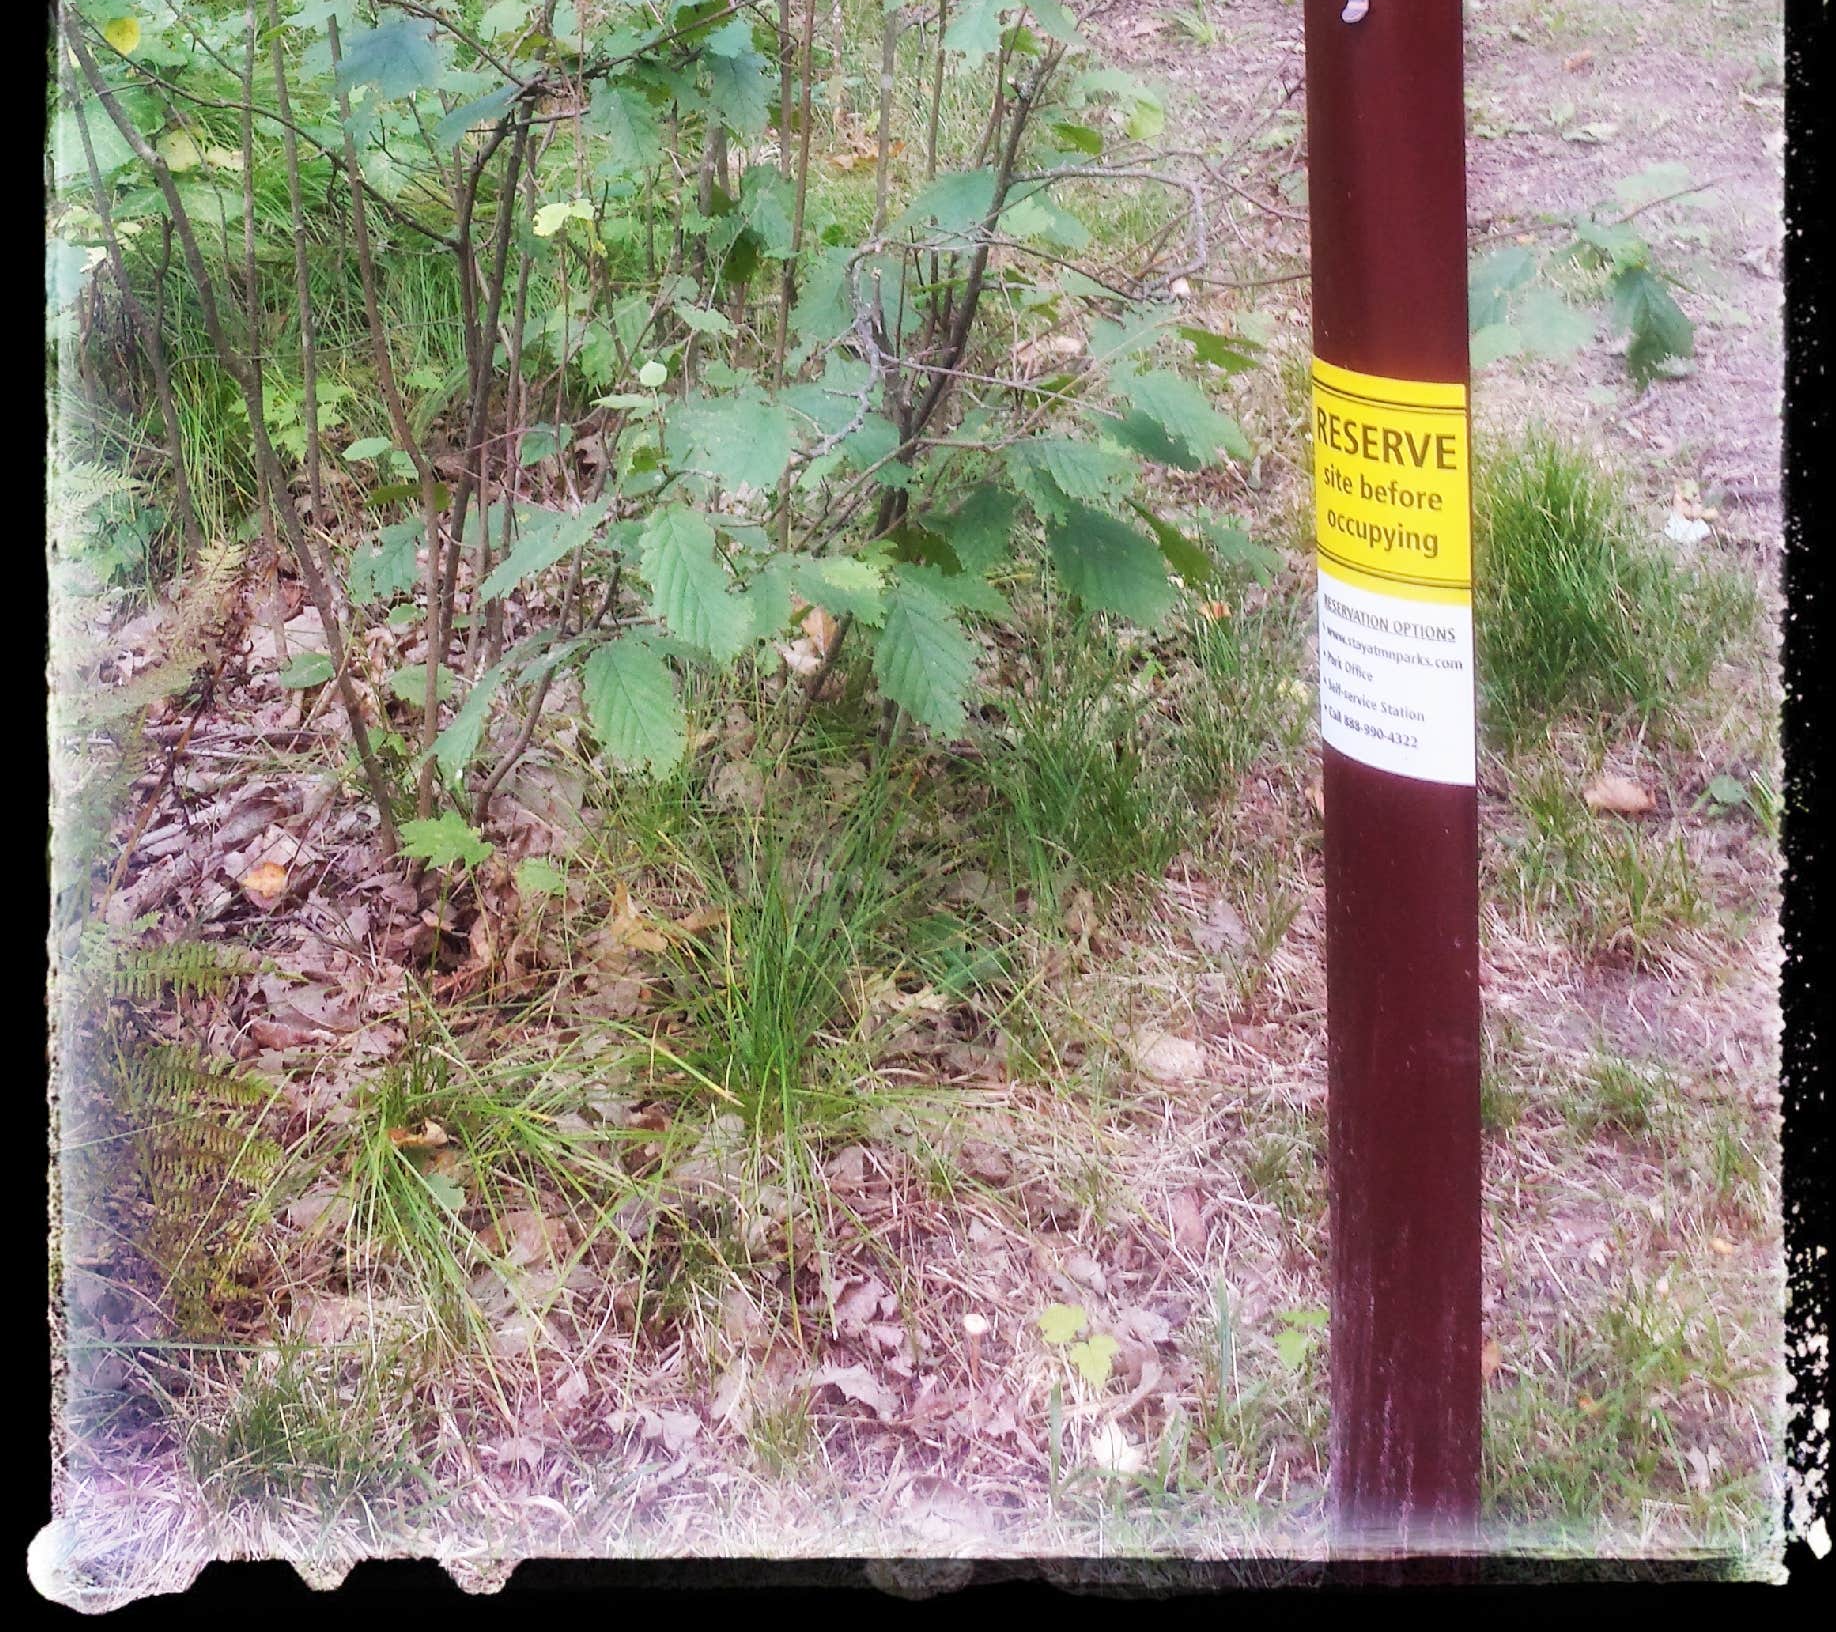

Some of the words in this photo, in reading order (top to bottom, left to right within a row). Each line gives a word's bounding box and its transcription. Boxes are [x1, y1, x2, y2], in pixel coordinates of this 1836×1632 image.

[1316, 406, 1457, 471] RESERVE
[1323, 463, 1353, 495] site
[1360, 473, 1443, 511] before
[1327, 509, 1439, 559] occupying
[1323, 593, 1389, 633] RESERVATION
[1393, 619, 1456, 642] OPTIONS
[1327, 649, 1343, 671] Park
[1344, 661, 1374, 682] Office
[1380, 701, 1425, 722] Station
